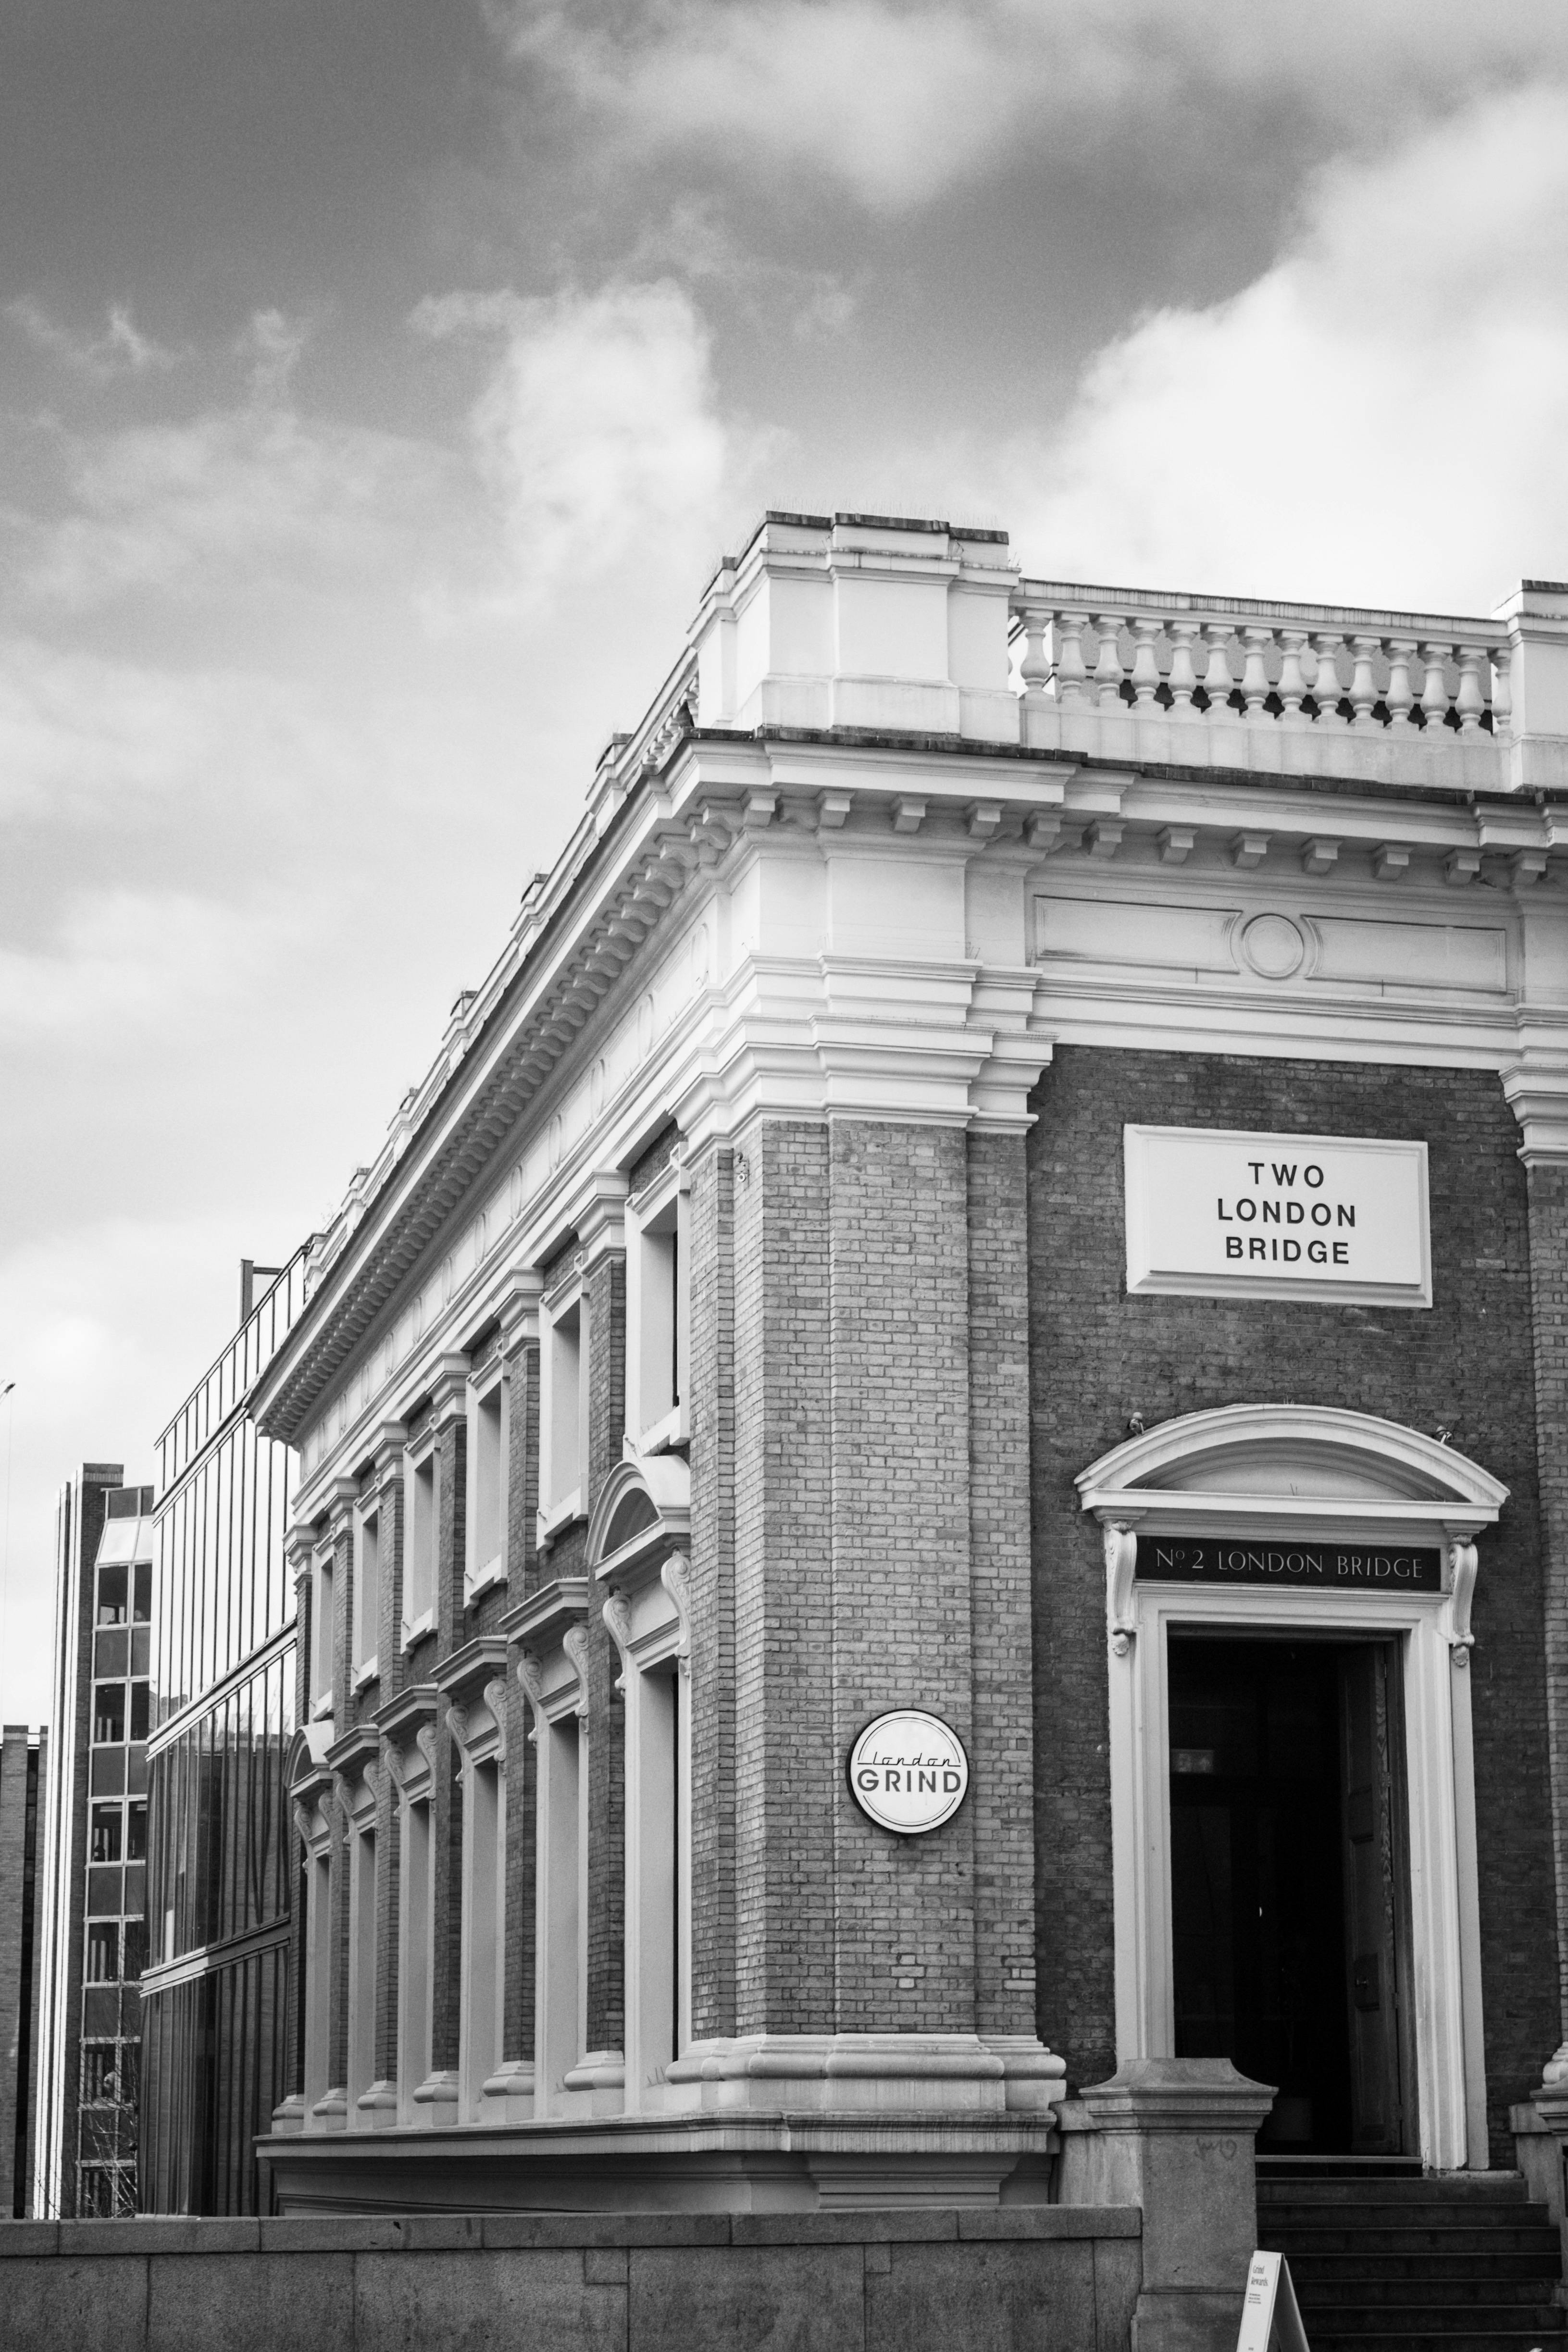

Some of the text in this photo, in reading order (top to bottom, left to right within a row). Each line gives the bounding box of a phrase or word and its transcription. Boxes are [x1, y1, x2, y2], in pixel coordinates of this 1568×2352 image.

[1248, 1162, 1324, 1188] TWO
[1218, 1198, 1355, 1227] LONDON
[1226, 1236, 1349, 1265] BRIDGE
[1191, 1549, 1204, 1569] 2
[1218, 1551, 1323, 1573] LONDON
[1337, 1556, 1423, 1578] BRIDGE
[872, 1751, 961, 1767] london
[857, 1769, 961, 1793] GRIND
[1253, 2265, 1265, 2274] Grind
